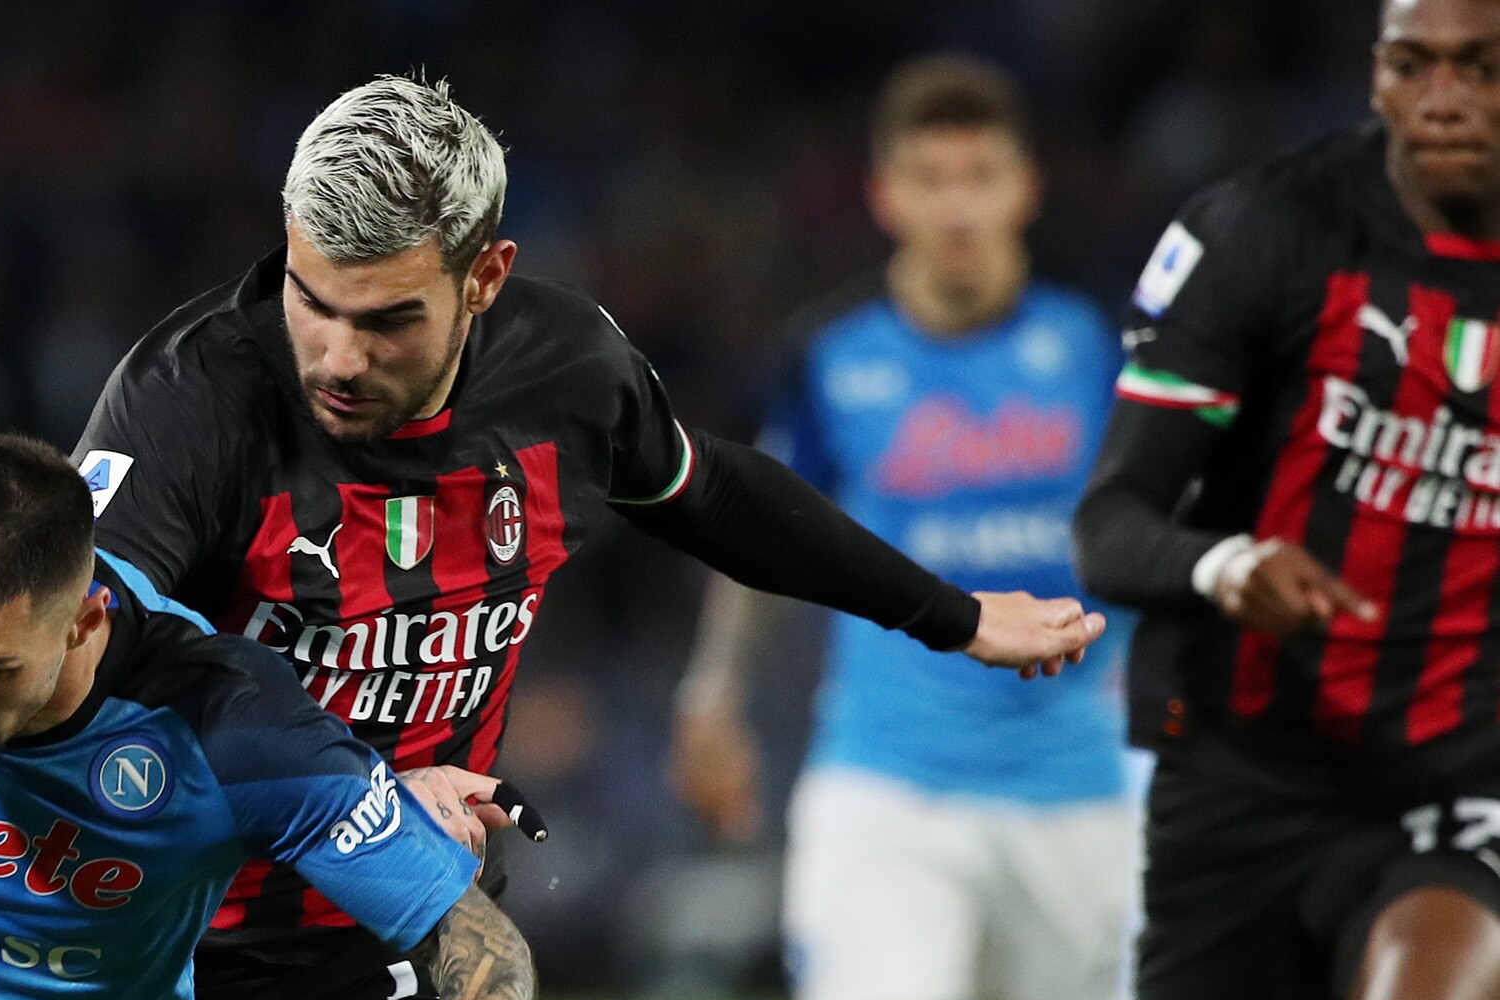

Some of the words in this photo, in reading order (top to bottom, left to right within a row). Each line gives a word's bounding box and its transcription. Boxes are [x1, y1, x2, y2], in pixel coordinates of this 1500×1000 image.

[243, 592, 538, 671] Emirates
[349, 665, 493, 724] BETTER
[113, 756, 153, 799] N
